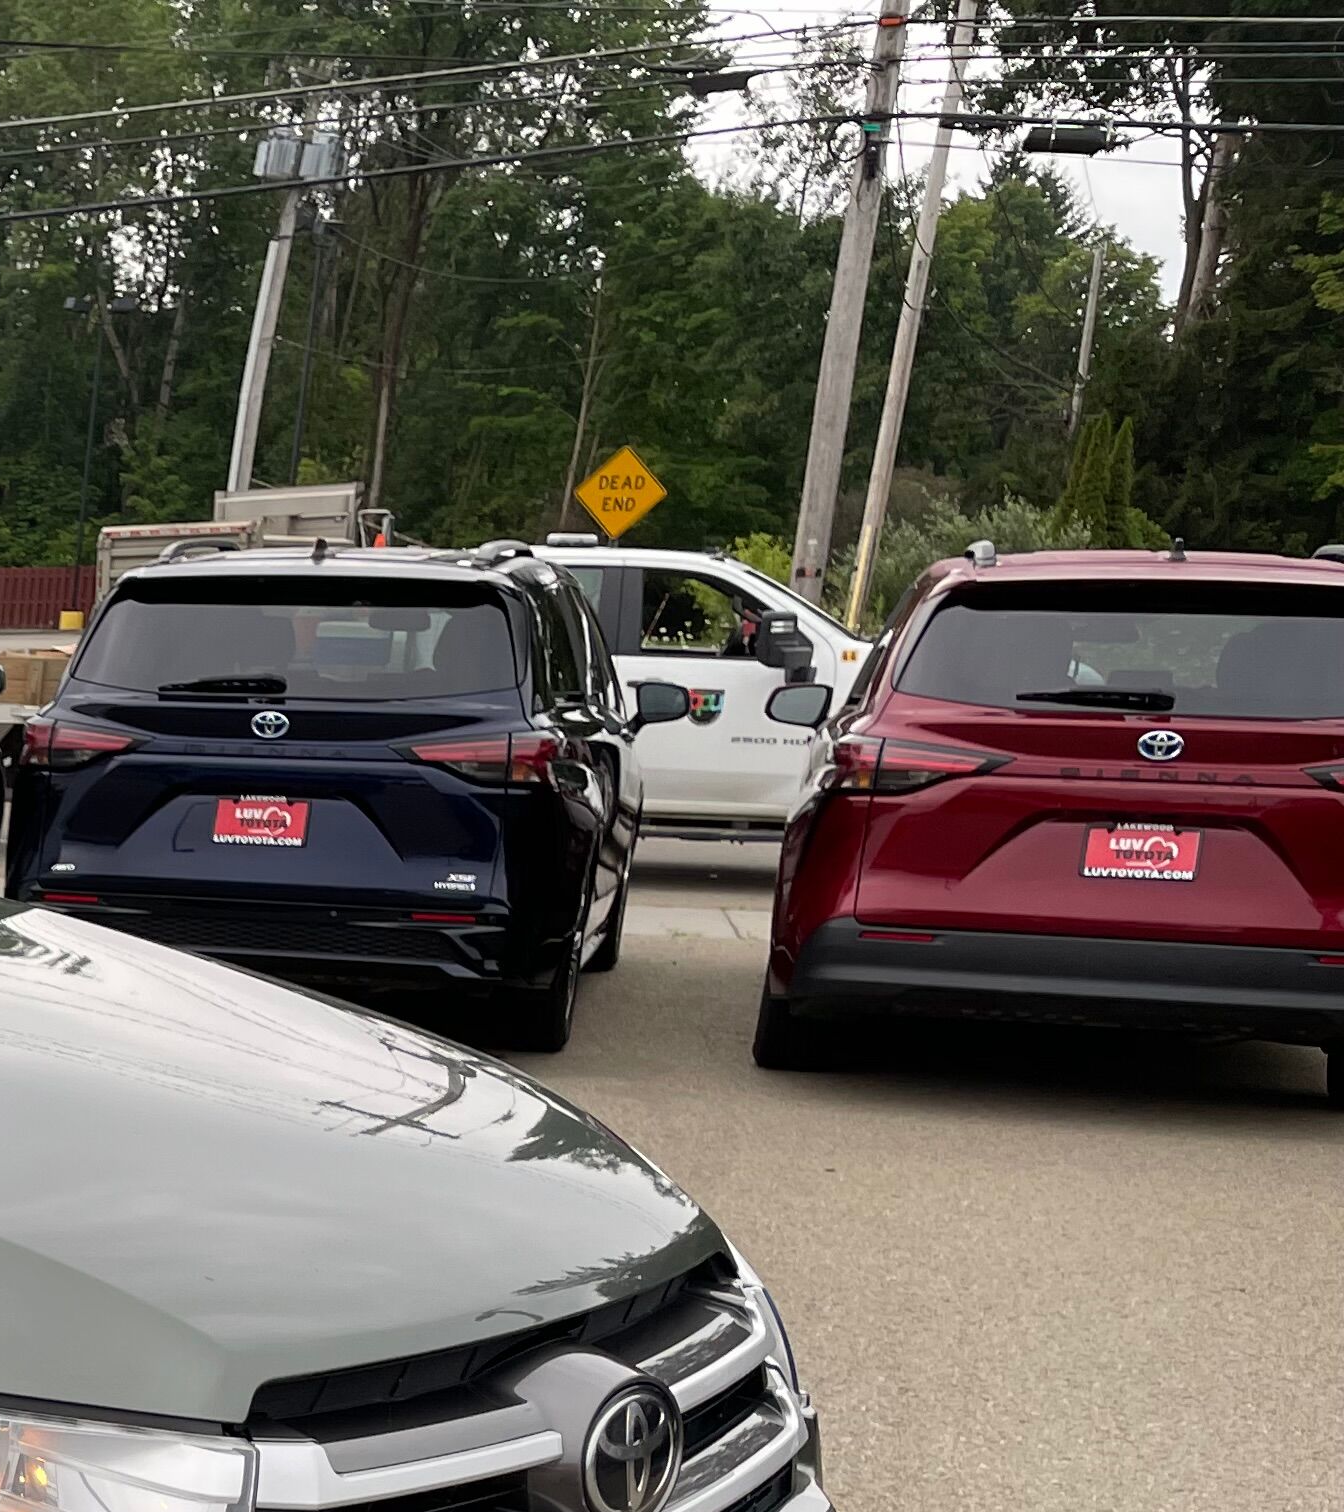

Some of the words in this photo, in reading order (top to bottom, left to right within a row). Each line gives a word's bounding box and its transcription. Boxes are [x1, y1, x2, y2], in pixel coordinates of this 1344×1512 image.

[598, 475, 646, 490] DEAD
[602, 497, 636, 512] END
[731, 737, 777, 745] 2500
[234, 807, 263, 819] LUV
[239, 818, 288, 828] TOYOTA
[1116, 823, 1175, 832] LAKEWOOD
[213, 834, 303, 847] LUVTOYOTA.COM
[1109, 838, 1144, 850] LUV
[1114, 850, 1175, 861] TOYOTA
[1083, 867, 1194, 880] LUVTOYOTA.COM
